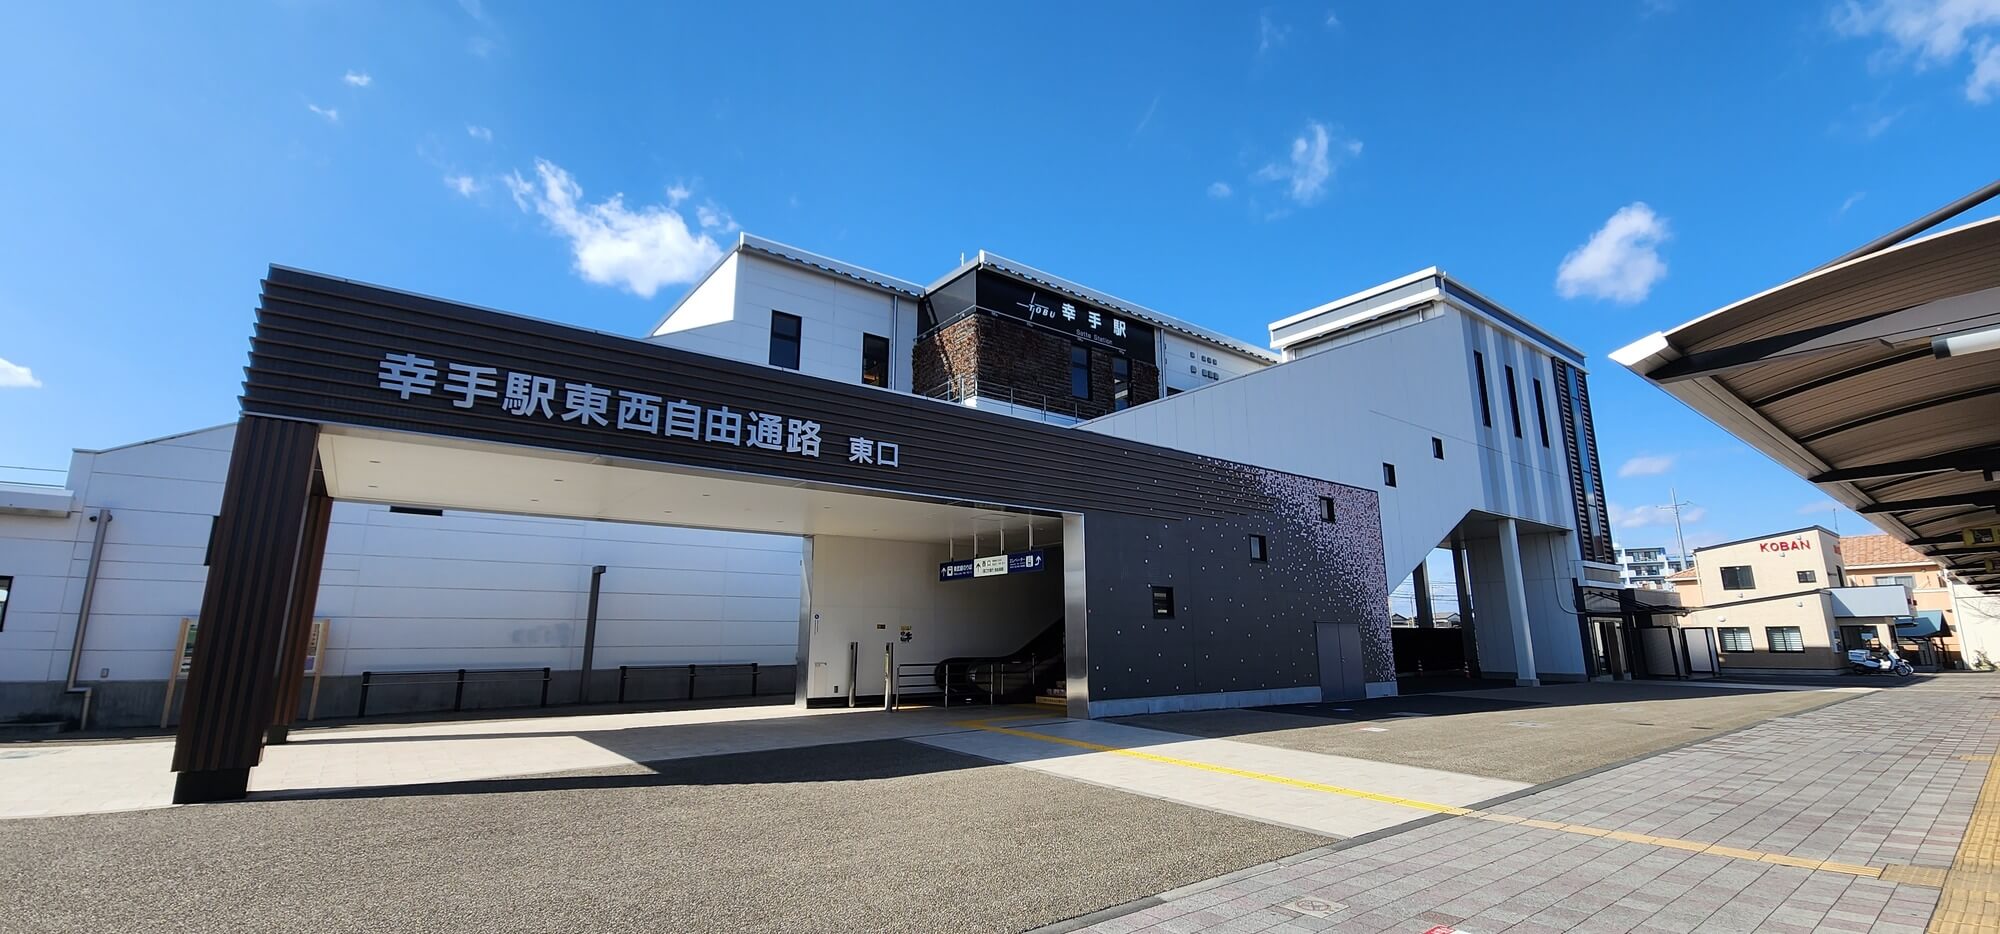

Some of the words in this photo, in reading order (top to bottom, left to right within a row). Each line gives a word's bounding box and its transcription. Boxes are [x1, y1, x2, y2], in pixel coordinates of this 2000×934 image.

[1028, 304, 1056, 319] TOBU
[1061, 303, 1127, 338] 幸手駅
[1093, 334, 1113, 345] Station
[378, 352, 822, 458] 幸手駅東西自由通路
[848, 436, 900, 468] 東口
[1760, 540, 1811, 552] KOBAN
